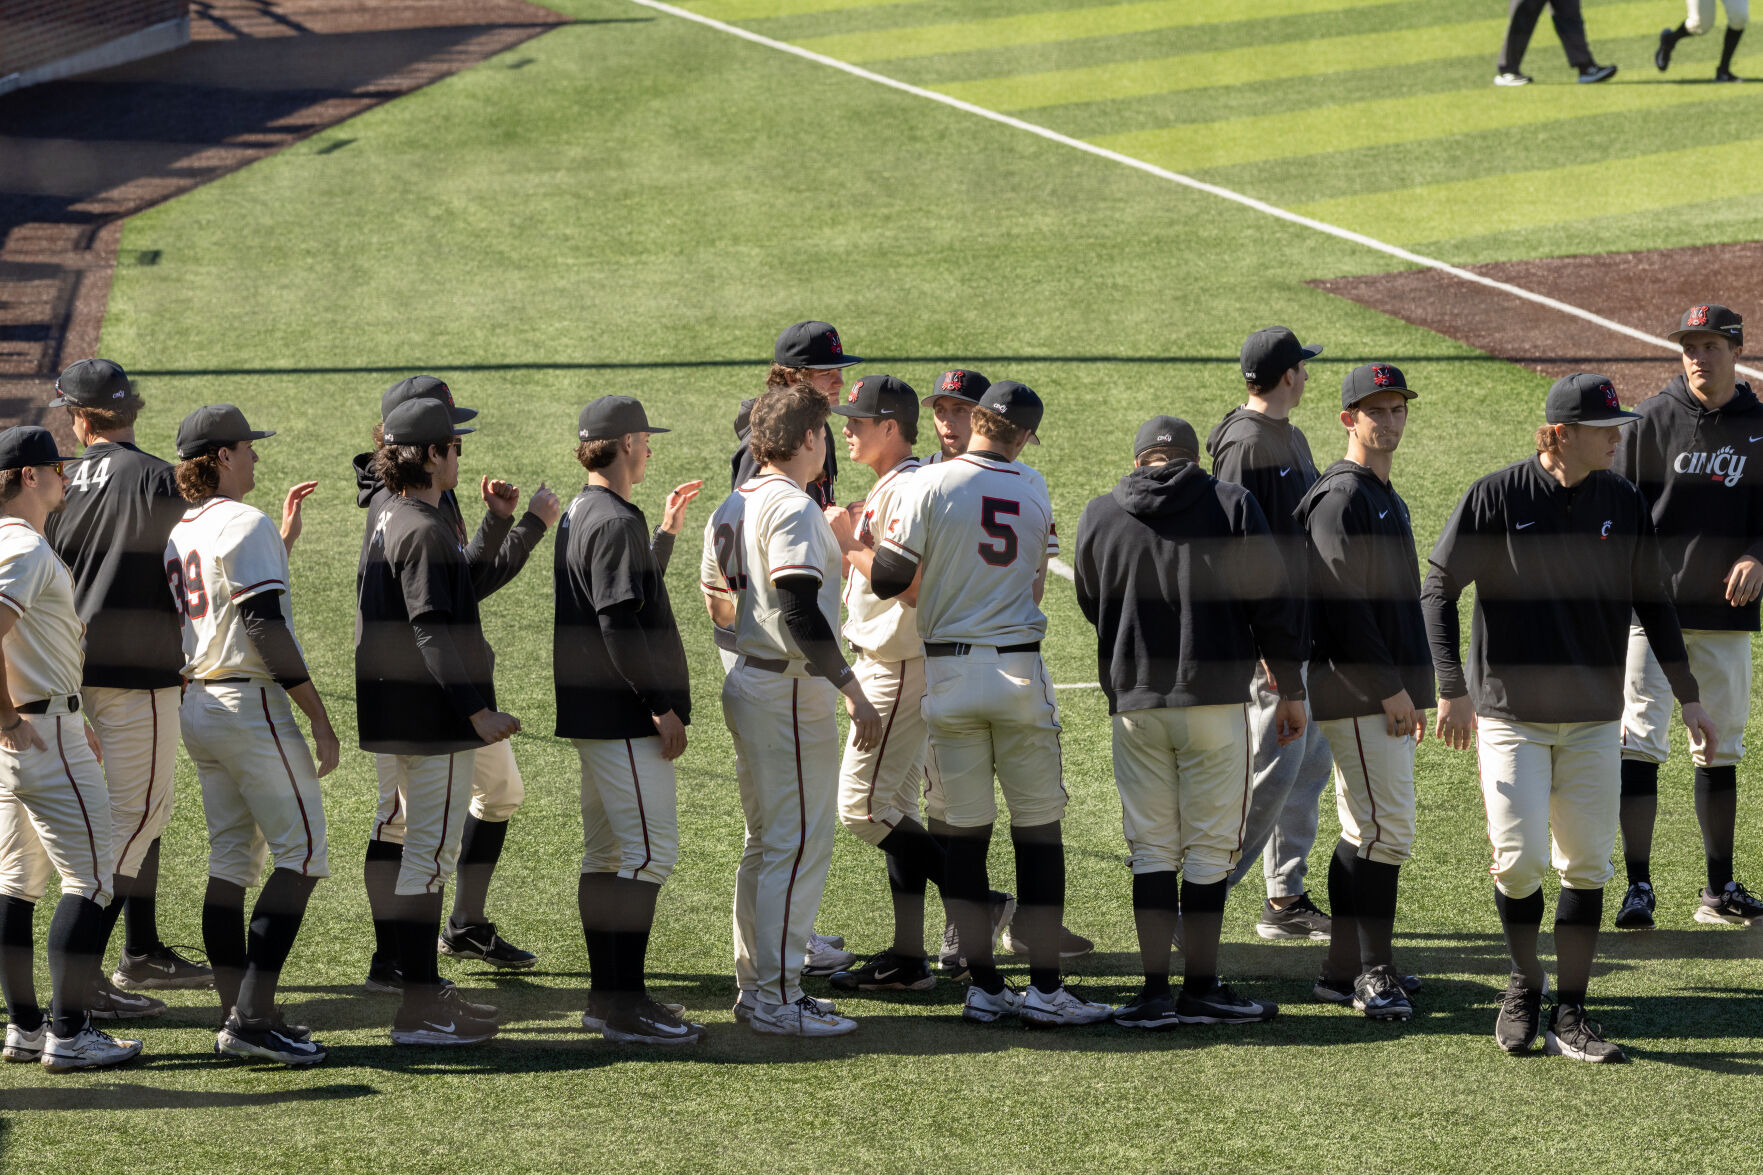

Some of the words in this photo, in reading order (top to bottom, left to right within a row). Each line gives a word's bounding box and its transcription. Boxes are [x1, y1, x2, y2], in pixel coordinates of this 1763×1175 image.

[71, 457, 112, 492] 44
[1674, 445, 1747, 487] CINCY
[714, 519, 747, 592] 21
[978, 495, 1020, 567] 5
[166, 549, 210, 627] 39
